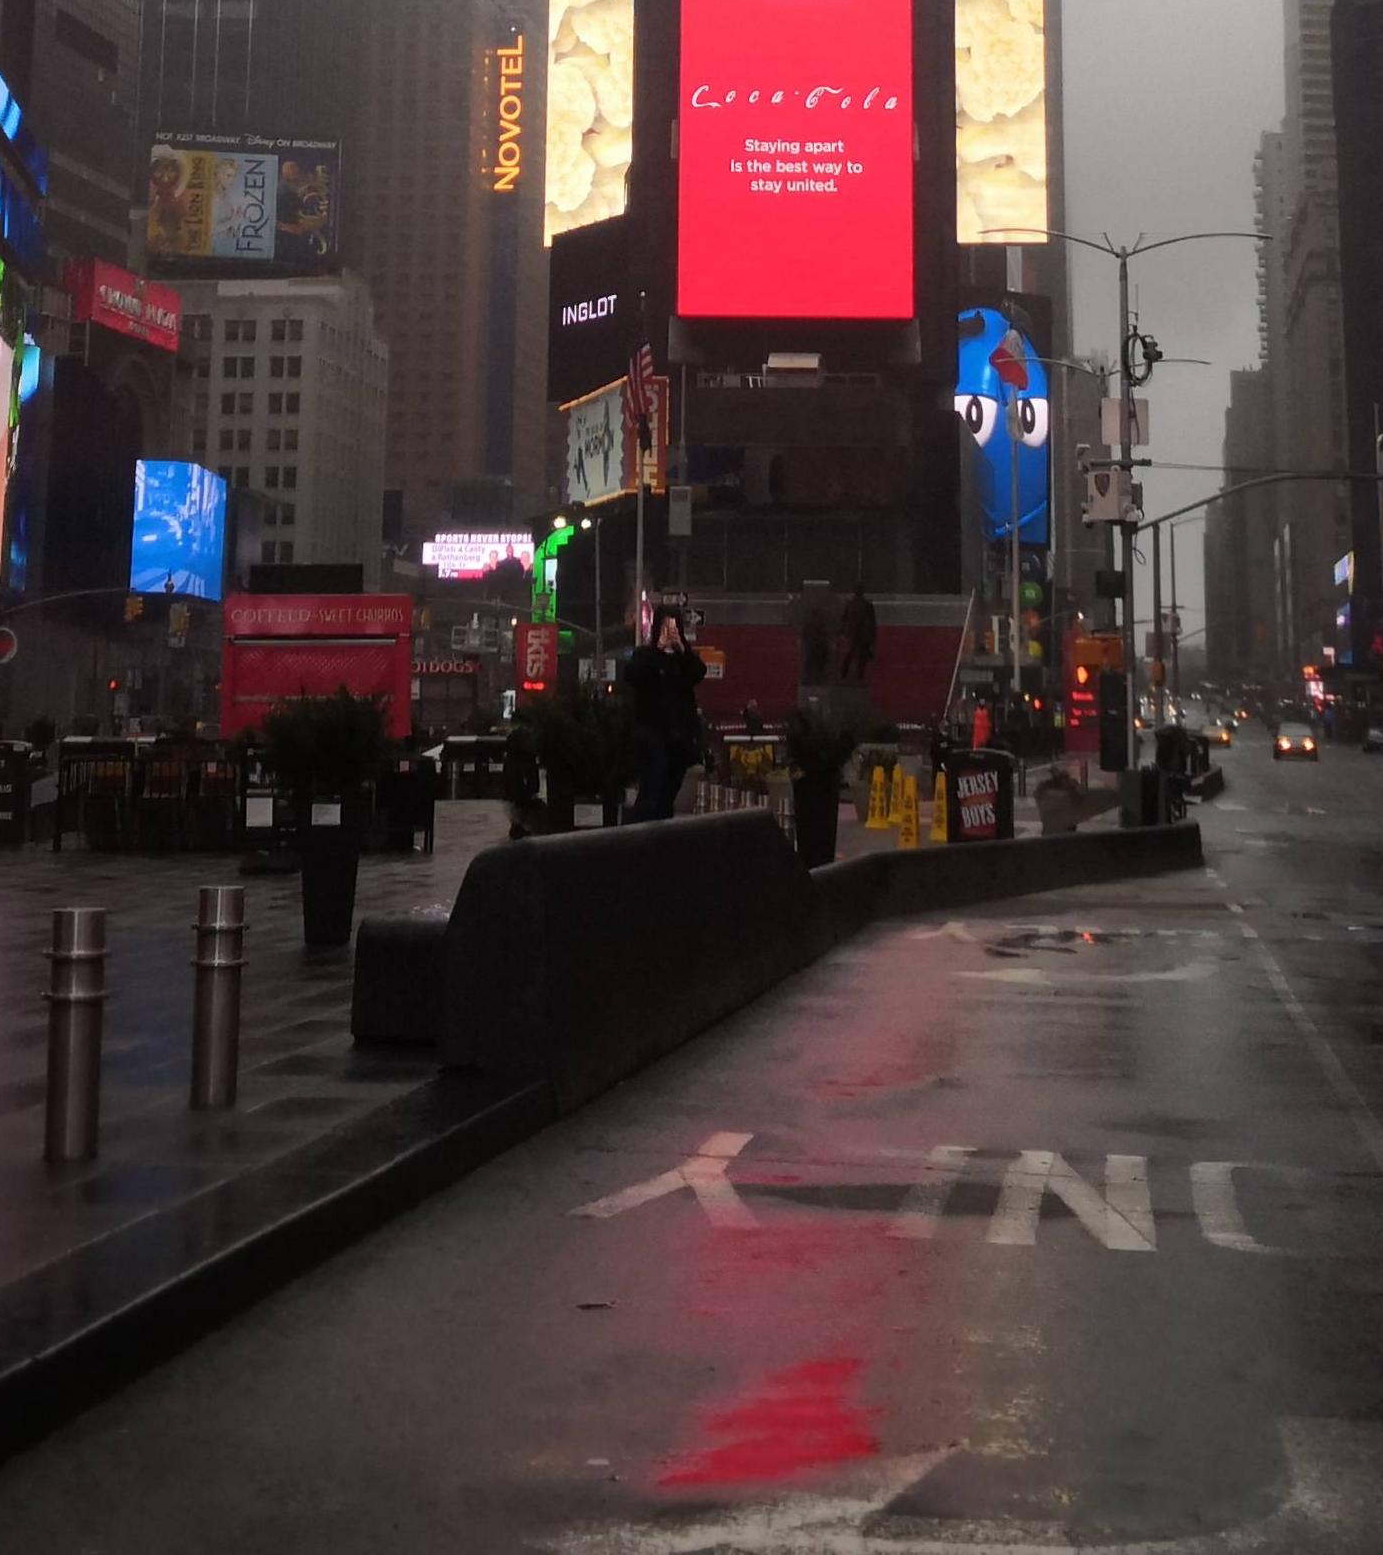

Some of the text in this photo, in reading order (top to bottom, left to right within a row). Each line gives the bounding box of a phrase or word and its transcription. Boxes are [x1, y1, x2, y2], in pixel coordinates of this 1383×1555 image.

[492, 33, 525, 193] NOVOTEL
[745, 139, 844, 156] Staying apart
[731, 159, 863, 177] is the best way to
[751, 178, 838, 194] stay united.
[236, 158, 270, 253] FROZEN
[561, 293, 618, 326] INGLOT
[526, 628, 552, 678] tkts
[956, 770, 1000, 799] JERSEY
[961, 803, 997, 829] BOYS
